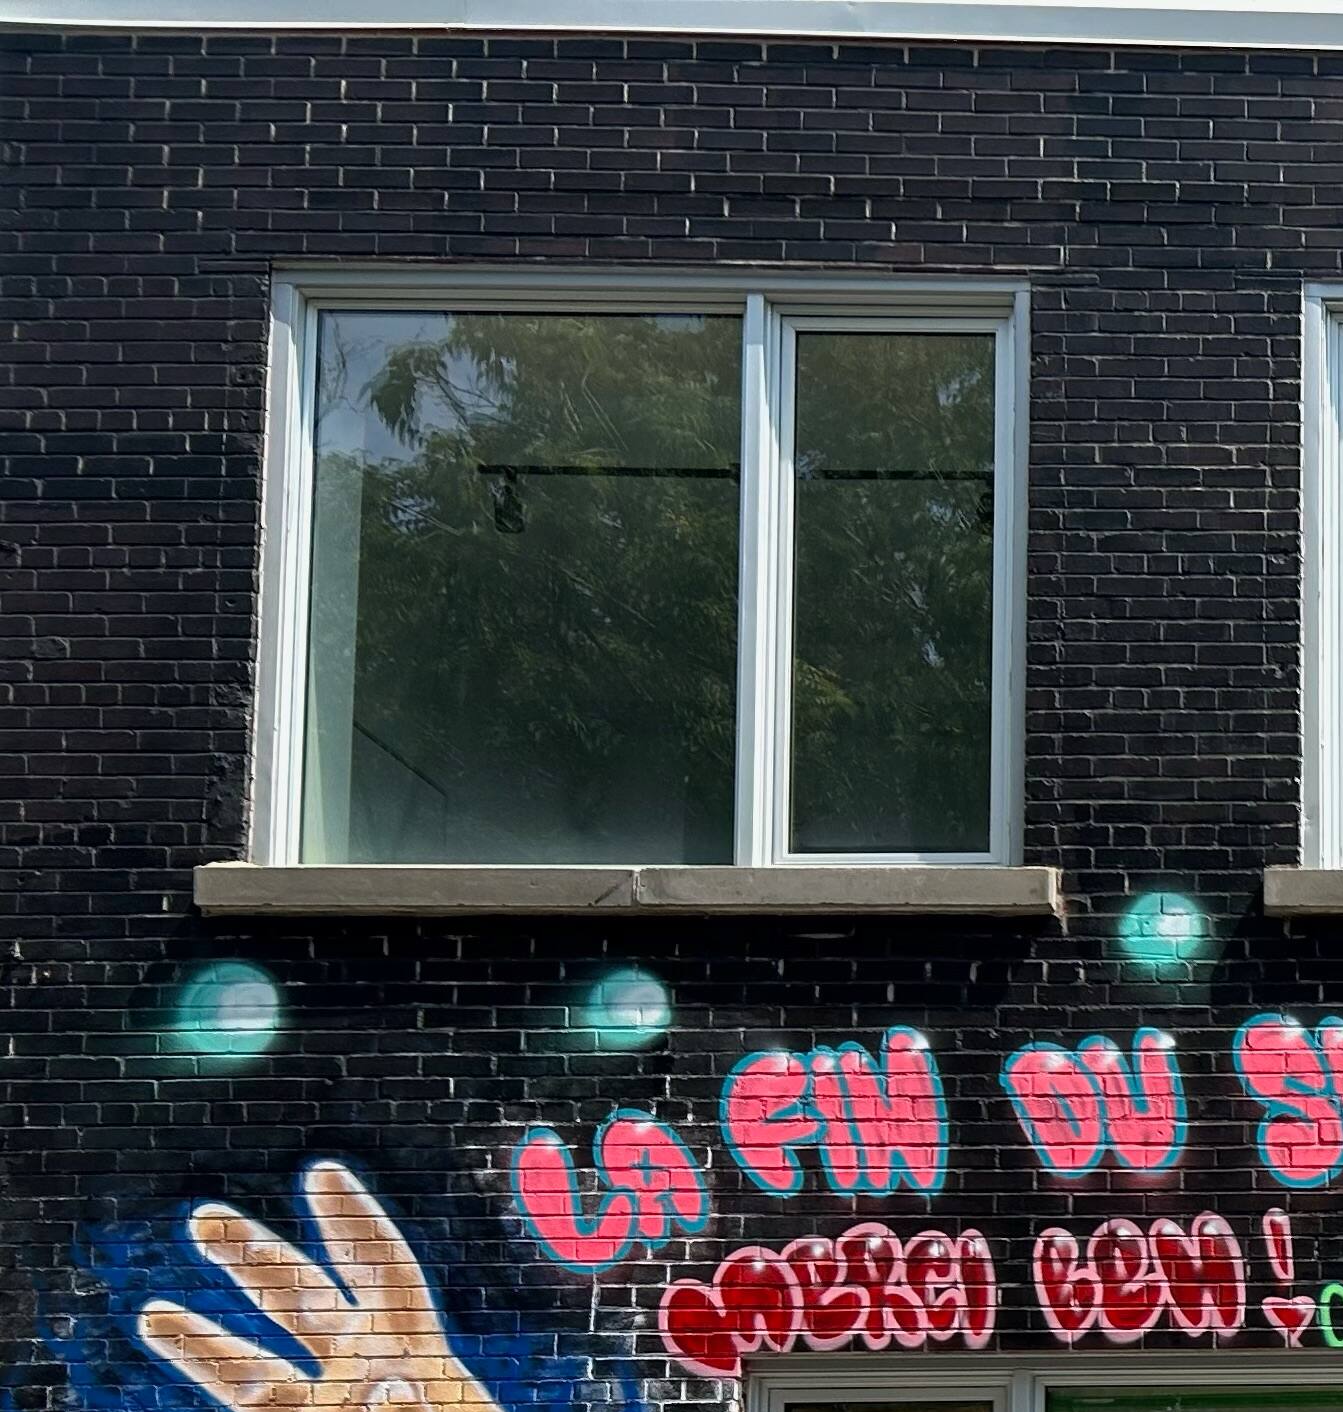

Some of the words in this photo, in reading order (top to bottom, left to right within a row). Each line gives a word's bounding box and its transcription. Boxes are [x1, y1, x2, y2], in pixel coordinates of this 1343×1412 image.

[510, 1106, 709, 1273] LA
[720, 1025, 948, 1198] FIN
[1001, 1026, 1188, 1180] DU
[658, 1221, 997, 1378] MERCI
